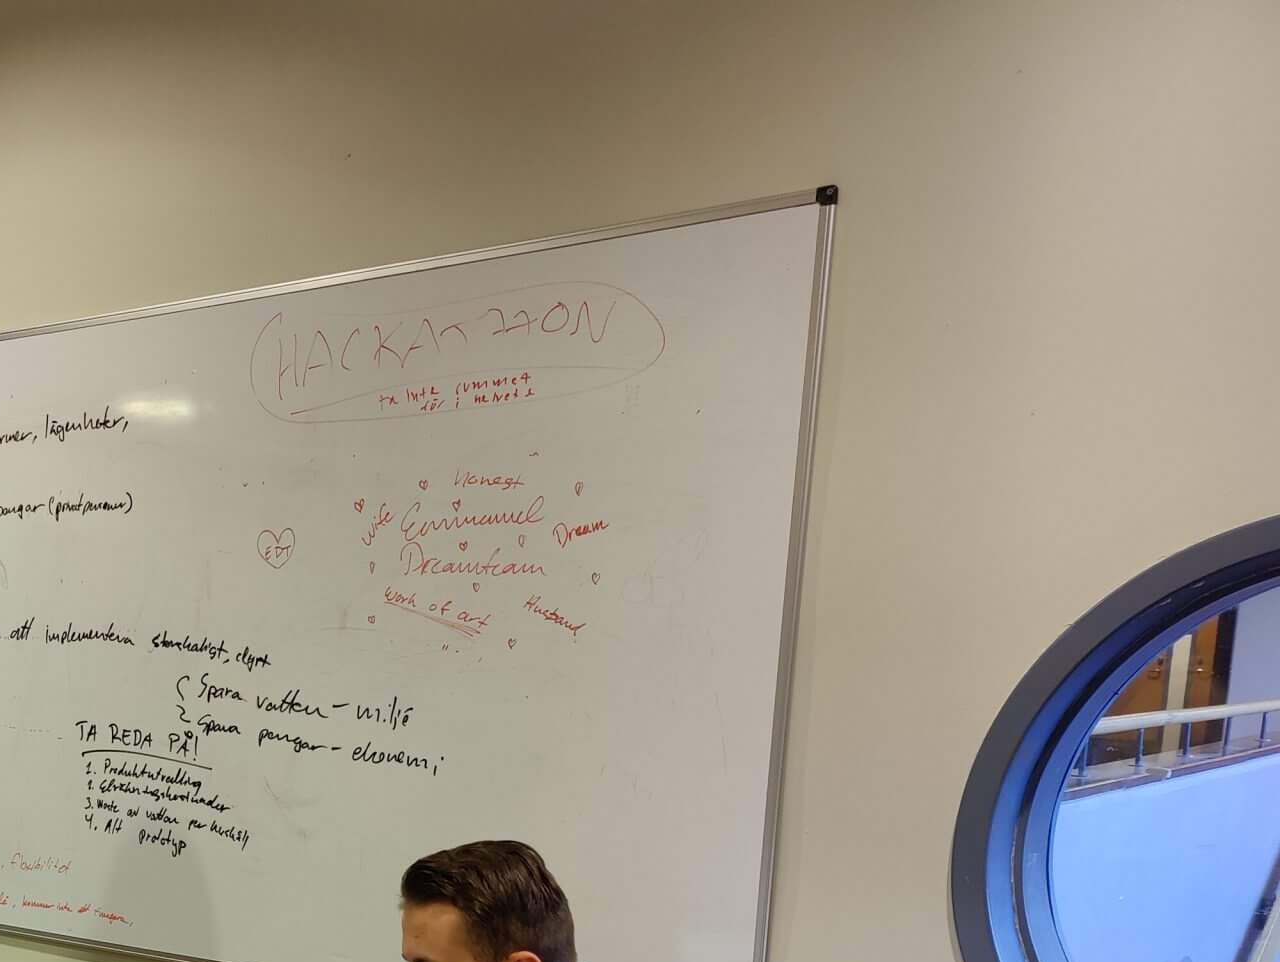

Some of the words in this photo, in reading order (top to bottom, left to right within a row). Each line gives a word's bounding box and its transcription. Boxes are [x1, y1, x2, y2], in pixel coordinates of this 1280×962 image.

[553, 519, 608, 548] Dream
[429, 601, 452, 616] of
[457, 613, 491, 628] art
[10, 617, 35, 641] att
[75, 721, 97, 742] TA
[109, 723, 153, 749] REDA
